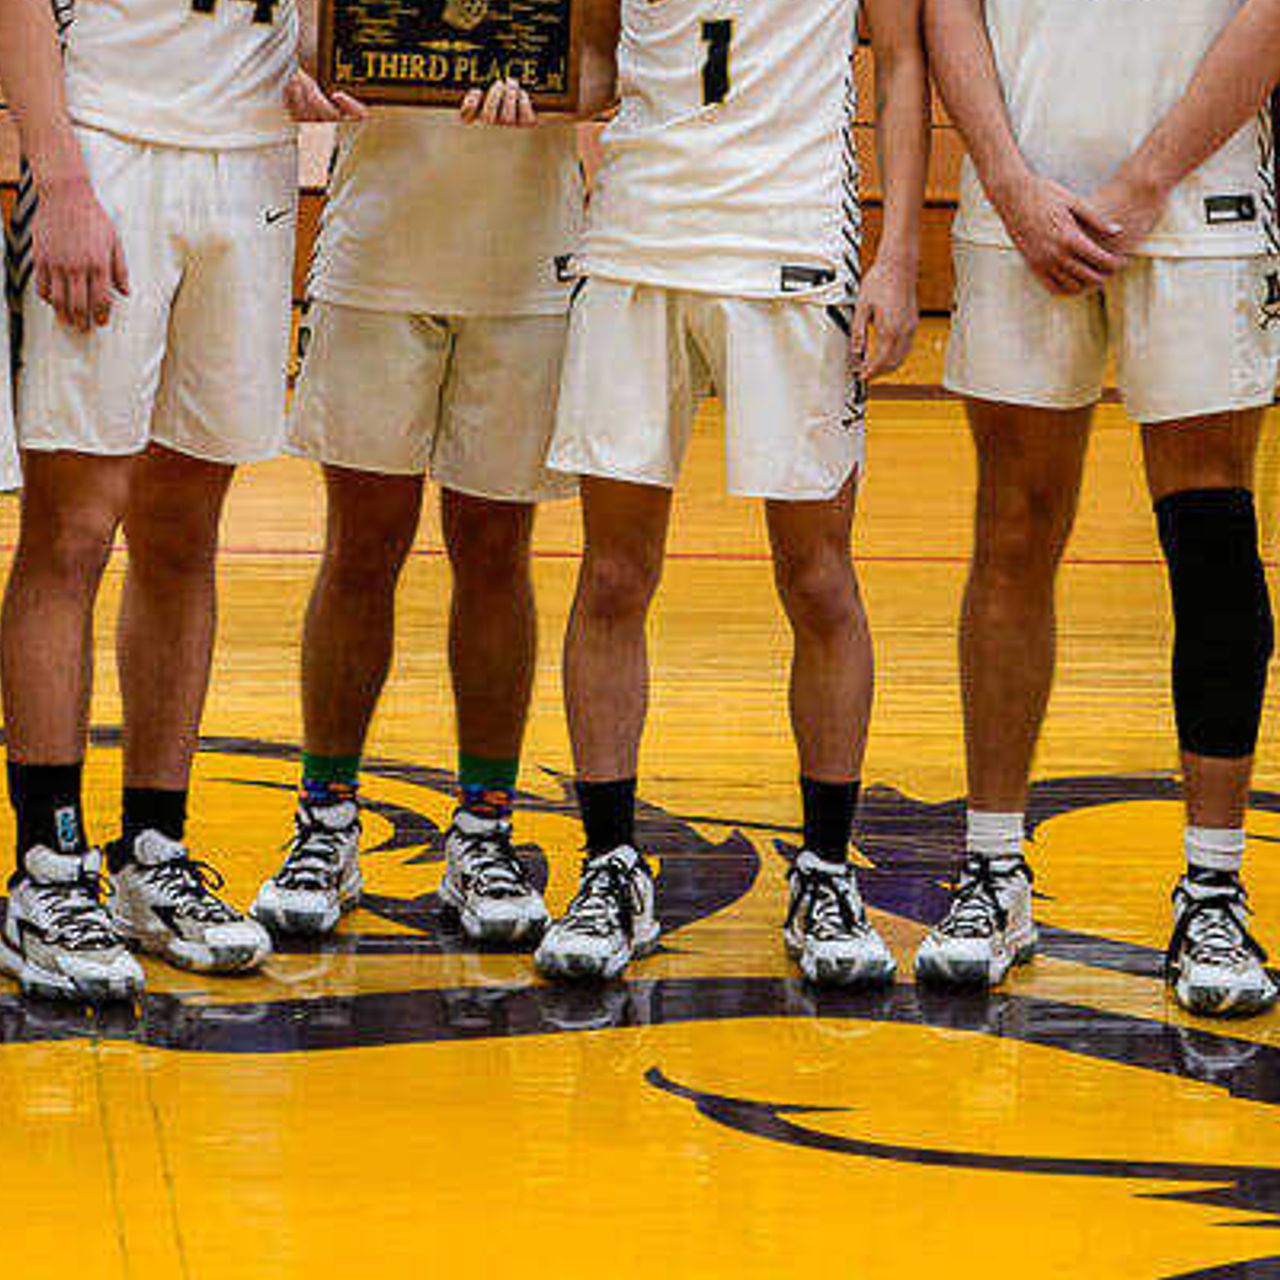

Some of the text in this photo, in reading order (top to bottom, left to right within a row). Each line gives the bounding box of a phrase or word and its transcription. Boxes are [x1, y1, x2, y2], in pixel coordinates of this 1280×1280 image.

[363, 50, 539, 85] THIRD PLACE
[698, 17, 737, 108] 1
